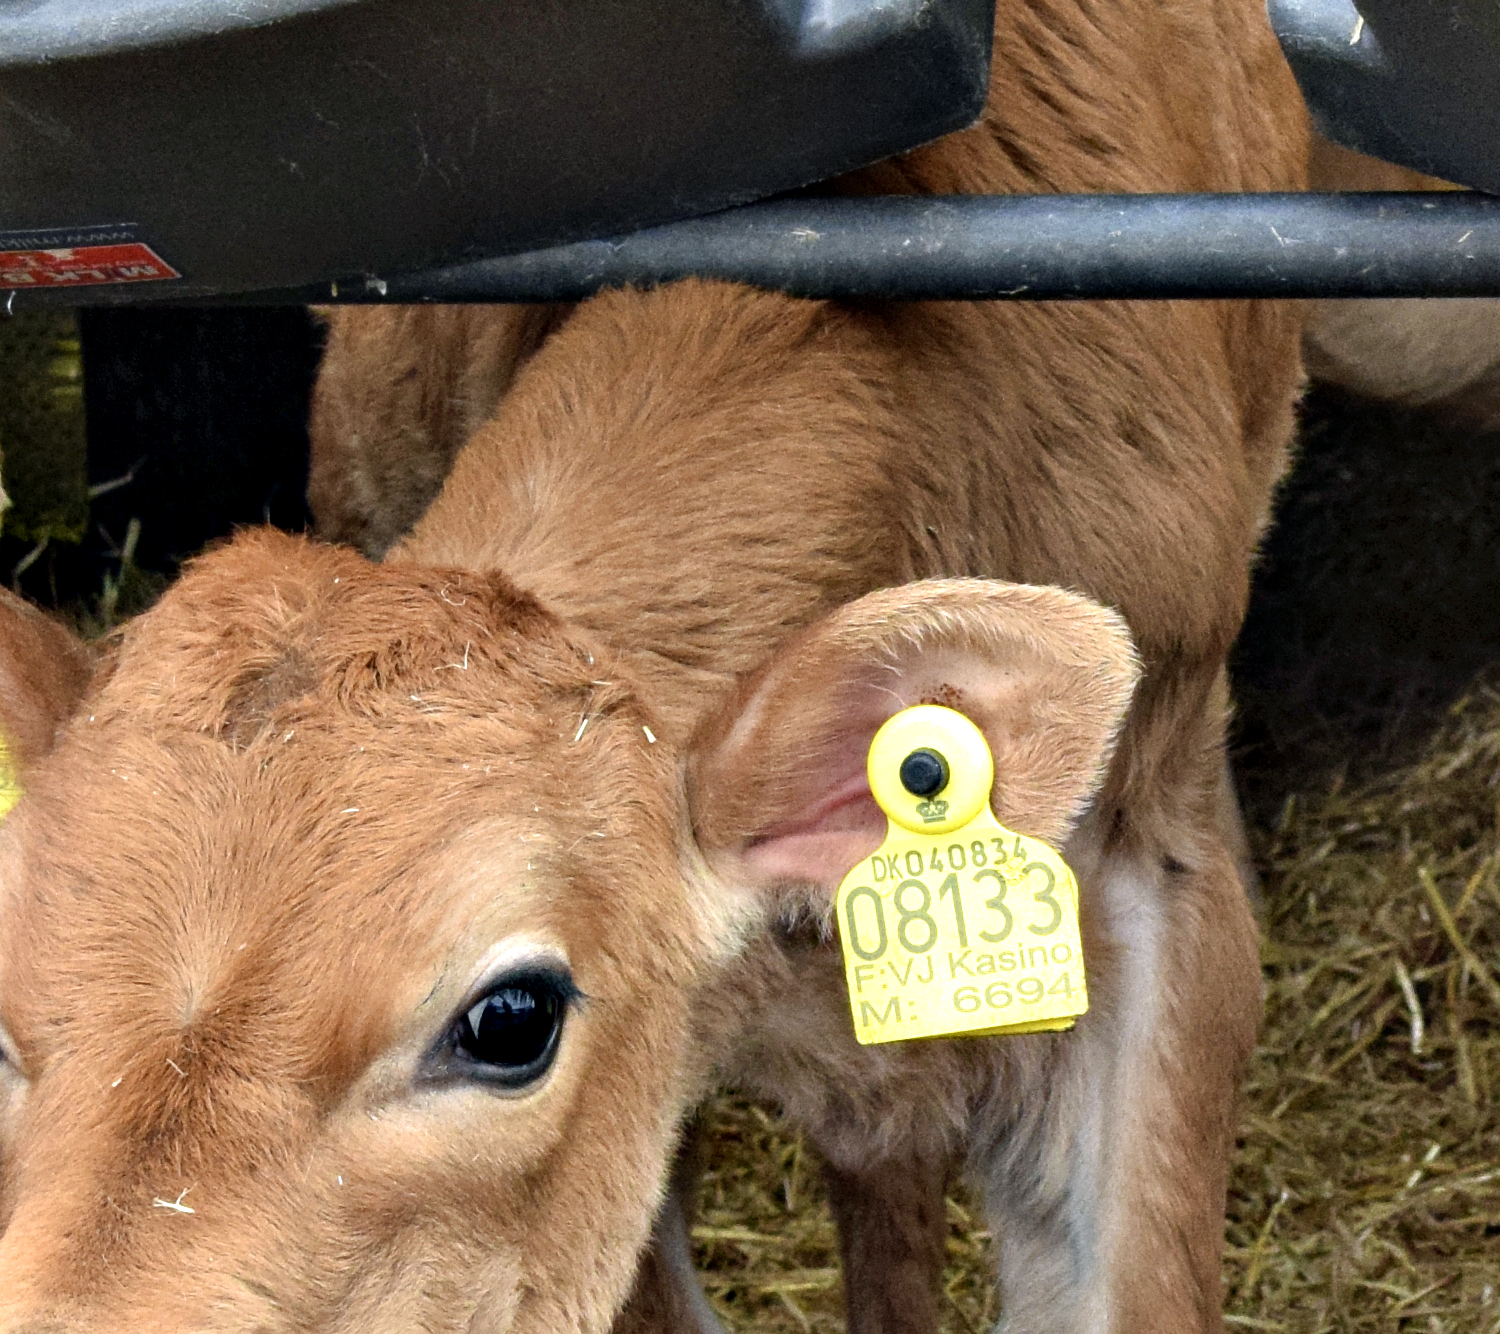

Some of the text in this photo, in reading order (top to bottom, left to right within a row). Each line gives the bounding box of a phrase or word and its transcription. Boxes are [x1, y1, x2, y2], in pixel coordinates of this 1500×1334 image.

[872, 837, 1027, 883] DK040834
[845, 861, 1062, 961] 08133
[948, 942, 1072, 980] Kasino
[859, 972, 1074, 1027] M: 6694
